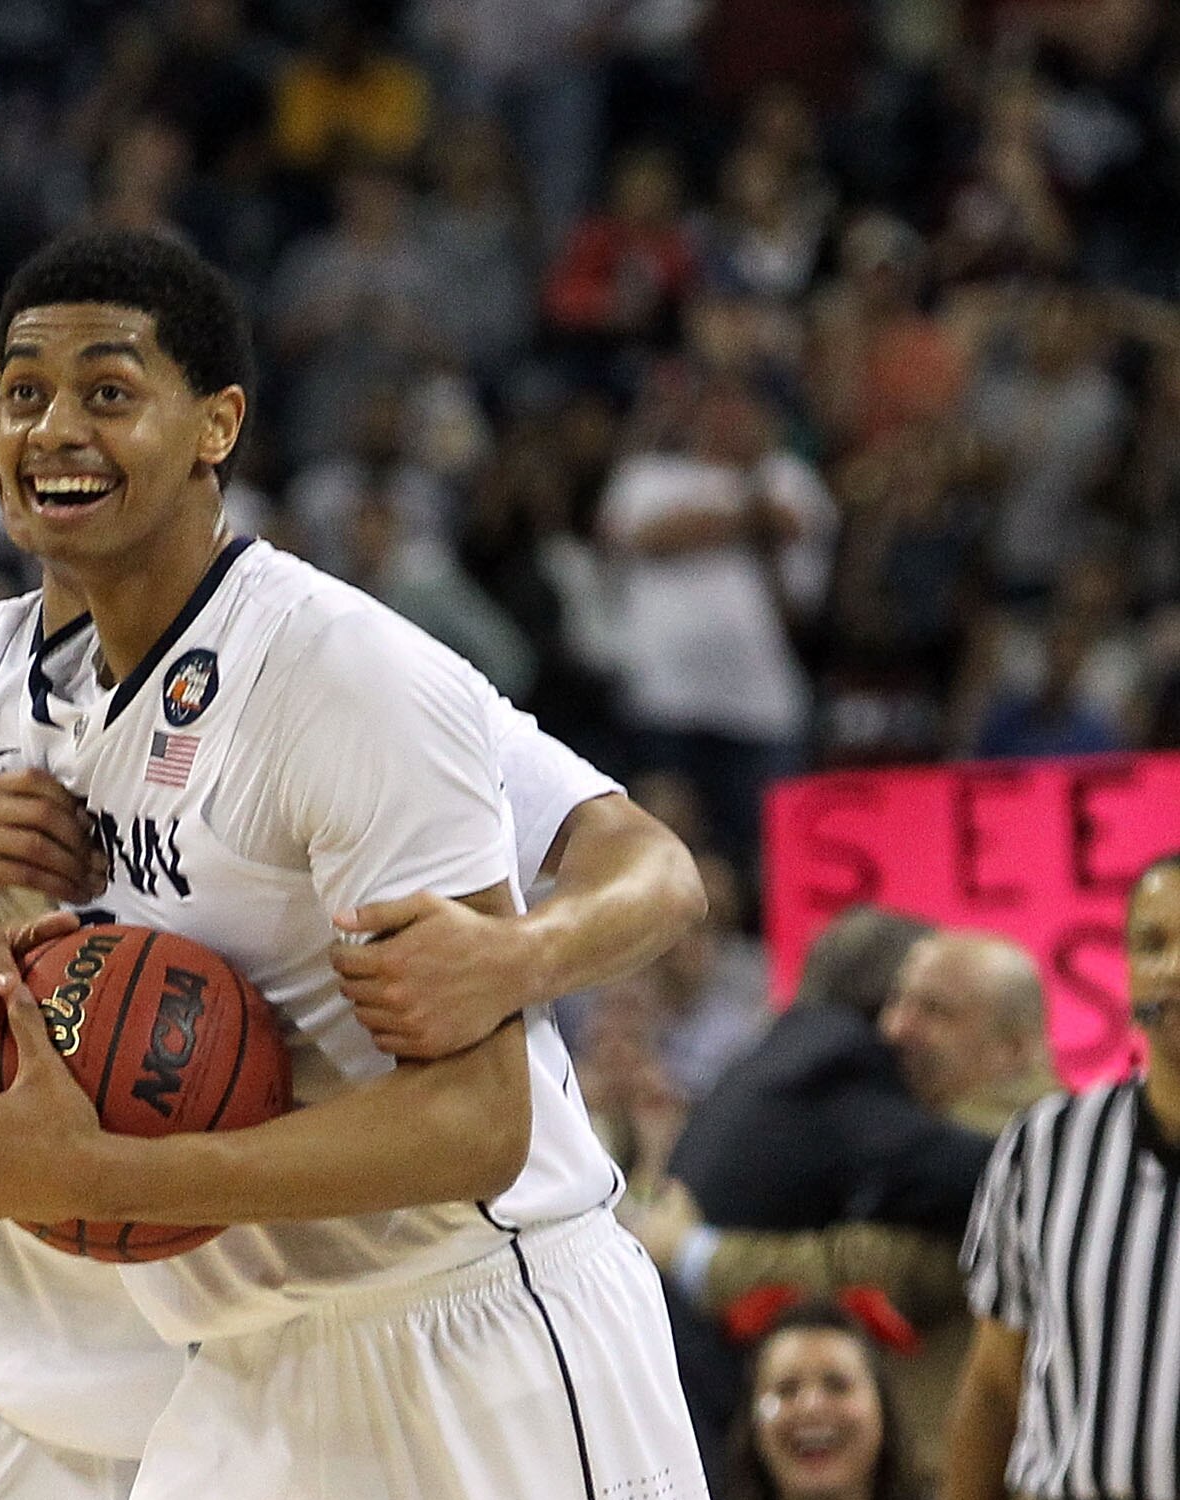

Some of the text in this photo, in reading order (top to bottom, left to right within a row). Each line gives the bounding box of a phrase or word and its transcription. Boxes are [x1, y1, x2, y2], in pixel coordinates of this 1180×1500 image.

[92, 808, 191, 897] NN
[798, 766, 1138, 908] SEE
[130, 966, 209, 1119] NCAA
